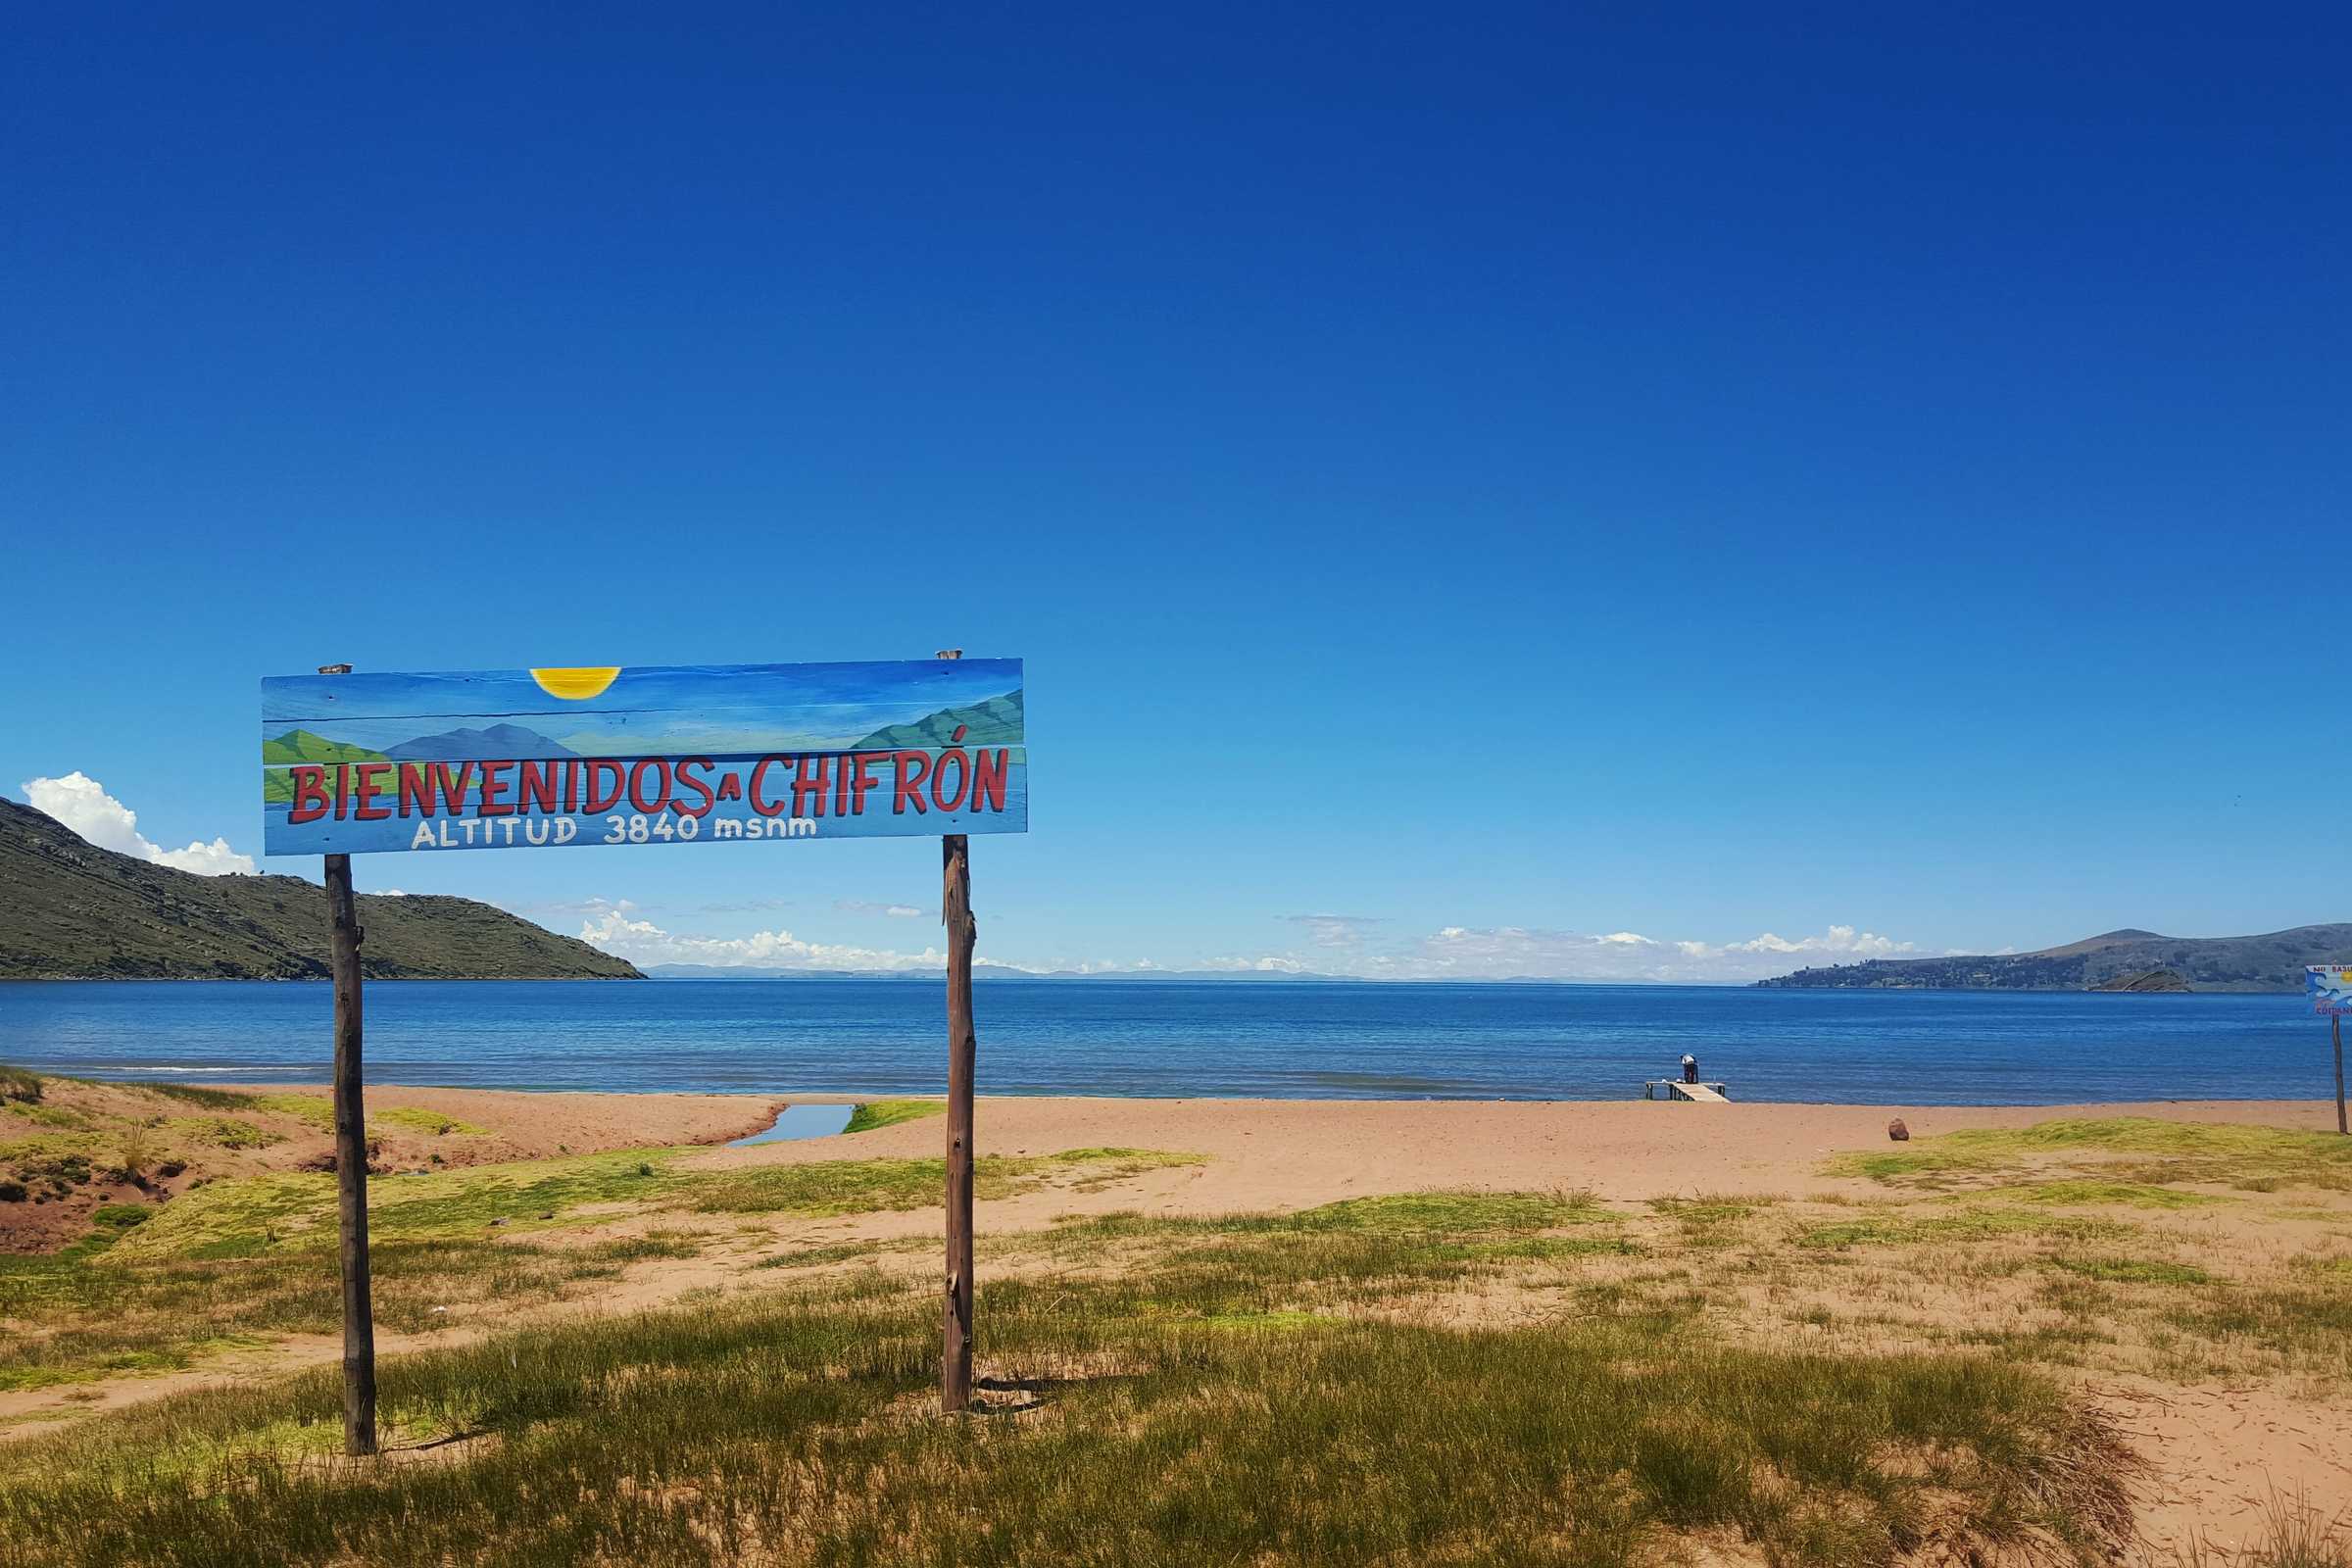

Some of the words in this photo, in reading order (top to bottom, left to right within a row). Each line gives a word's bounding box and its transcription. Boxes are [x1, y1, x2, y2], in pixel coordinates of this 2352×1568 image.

[288, 756, 715, 825] BIENVENIDOS
[716, 772, 743, 801] A
[748, 724, 1009, 818] CHIFRÓN
[411, 815, 577, 850] ALTITUD
[604, 812, 699, 844] 3840
[713, 817, 817, 839] msnm
